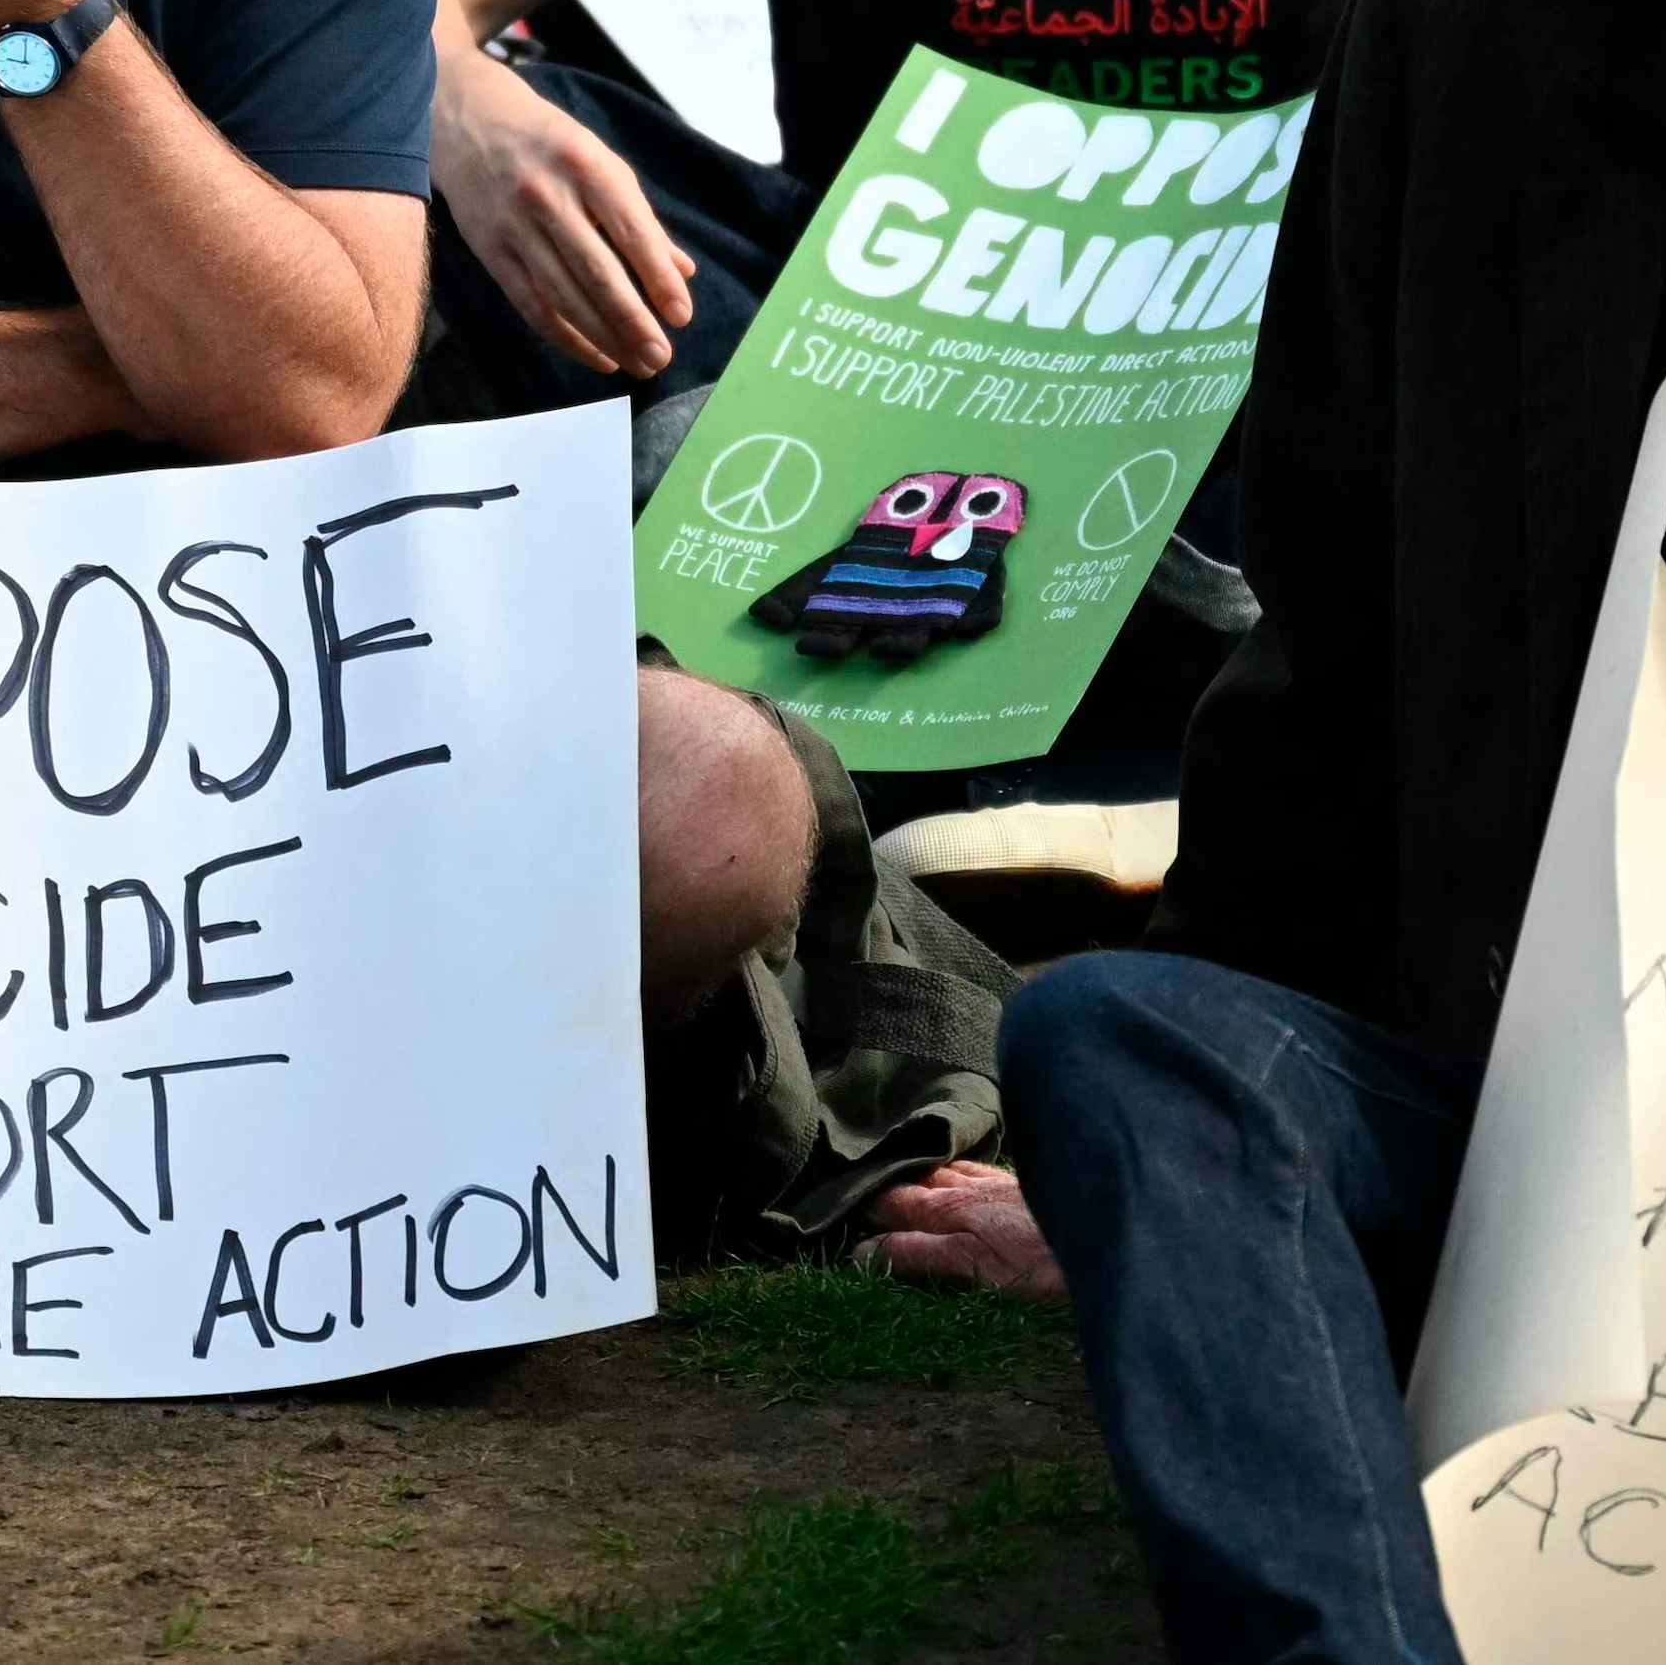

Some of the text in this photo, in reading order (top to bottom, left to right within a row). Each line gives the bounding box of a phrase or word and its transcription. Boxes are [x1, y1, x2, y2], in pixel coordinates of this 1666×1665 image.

[975, 54, 1264, 104] EADERS
[895, 68, 968, 154] I
[825, 174, 1280, 335] GENOCID
[799, 298, 1256, 373] I SUPPORT NON-VIOLENT DIRECT ACTION
[771, 328, 1252, 428] I SUPPORT PALESTINE ACTION
[659, 538, 768, 592] PEACE
[679, 523, 779, 557] WE SUPPORT
[1053, 554, 1132, 576] WE DO NOT
[1040, 573, 1121, 603] COMPLY
[1043, 606, 1078, 621] .ORG
[828, 707, 892, 723] ACTION
[899, 710, 915, 726] &
[192, 1154, 620, 1360] ACTION
